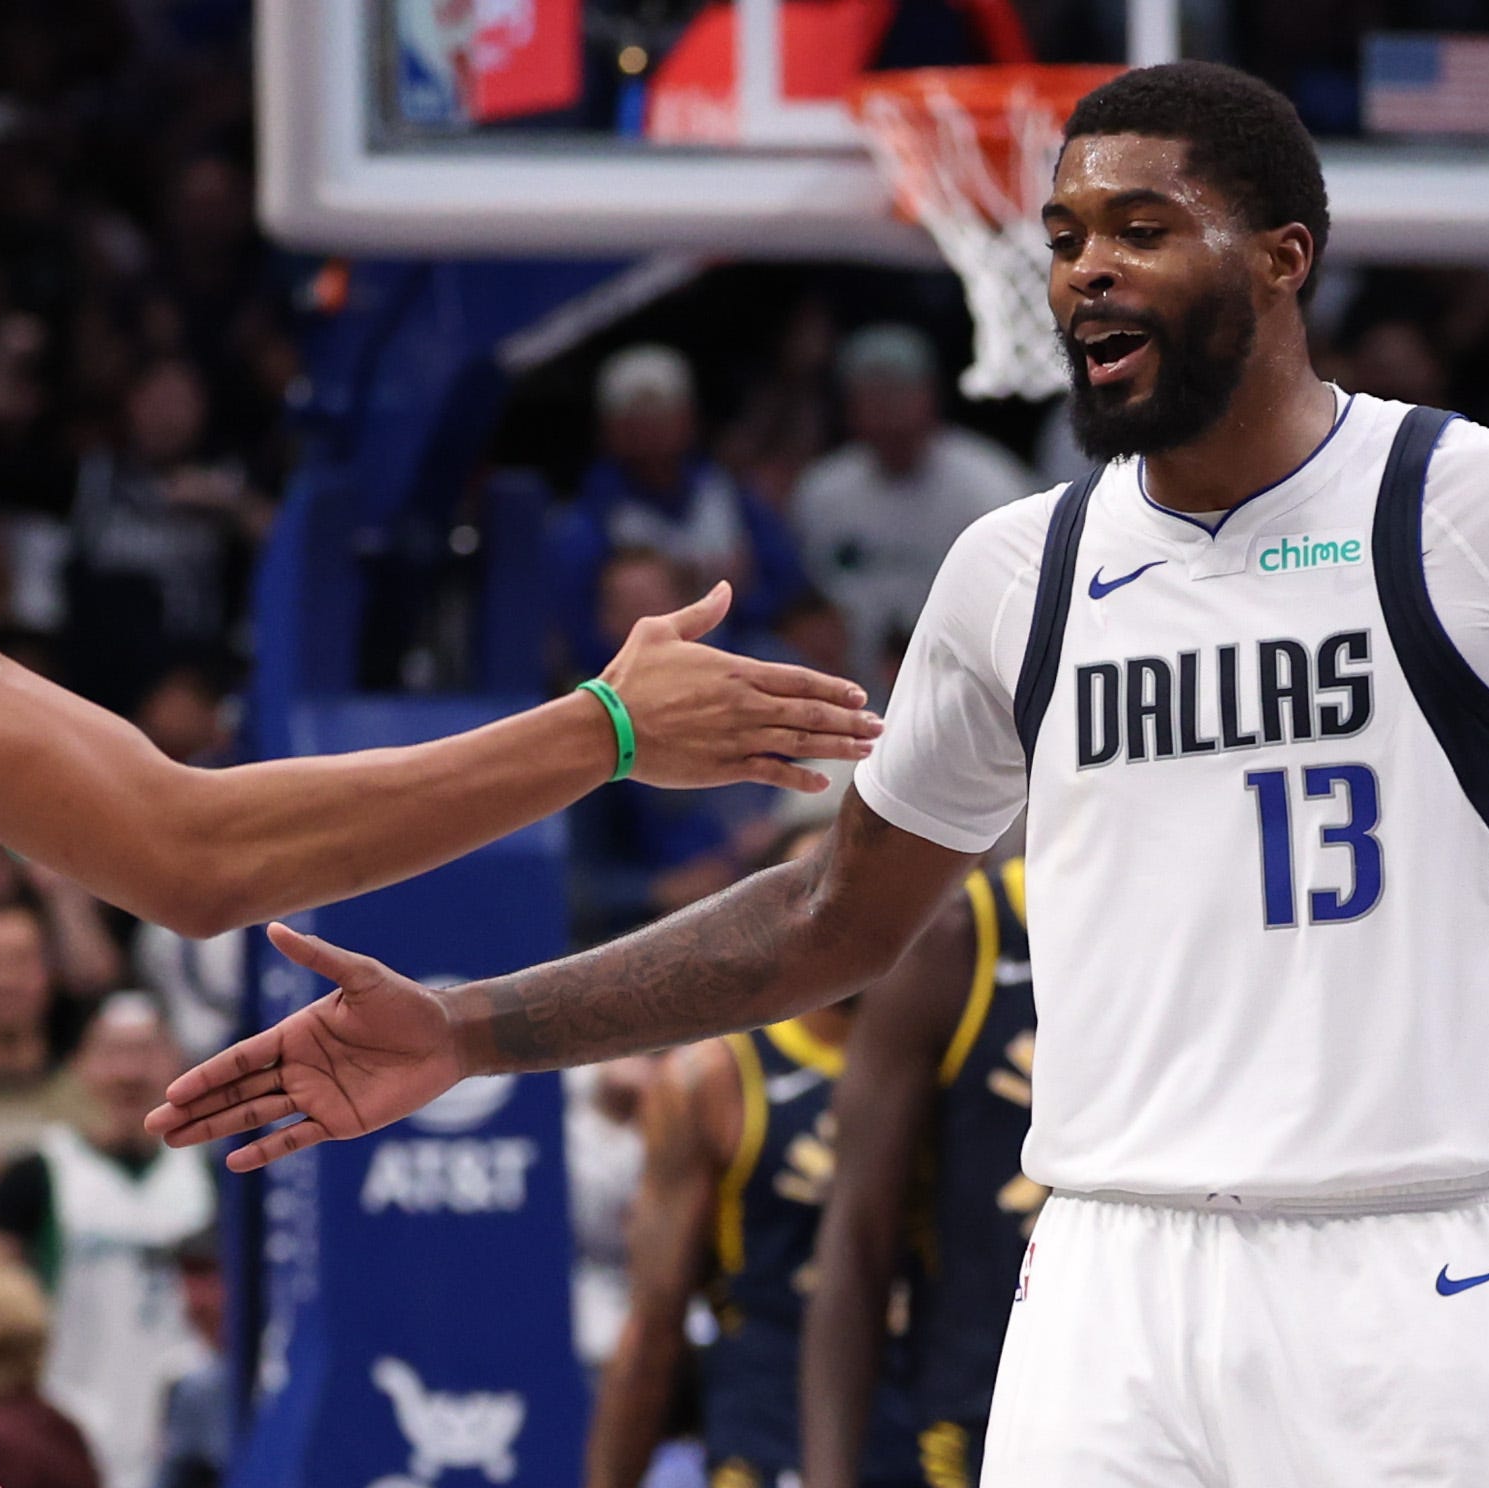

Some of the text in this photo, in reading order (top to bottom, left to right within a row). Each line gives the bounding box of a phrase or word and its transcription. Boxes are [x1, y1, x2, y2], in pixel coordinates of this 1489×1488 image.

[1259, 536, 1361, 571] chime
[1074, 628, 1374, 772] DALLAS
[1243, 762, 1386, 930] 13
[362, 1137, 536, 1213] AT&T
